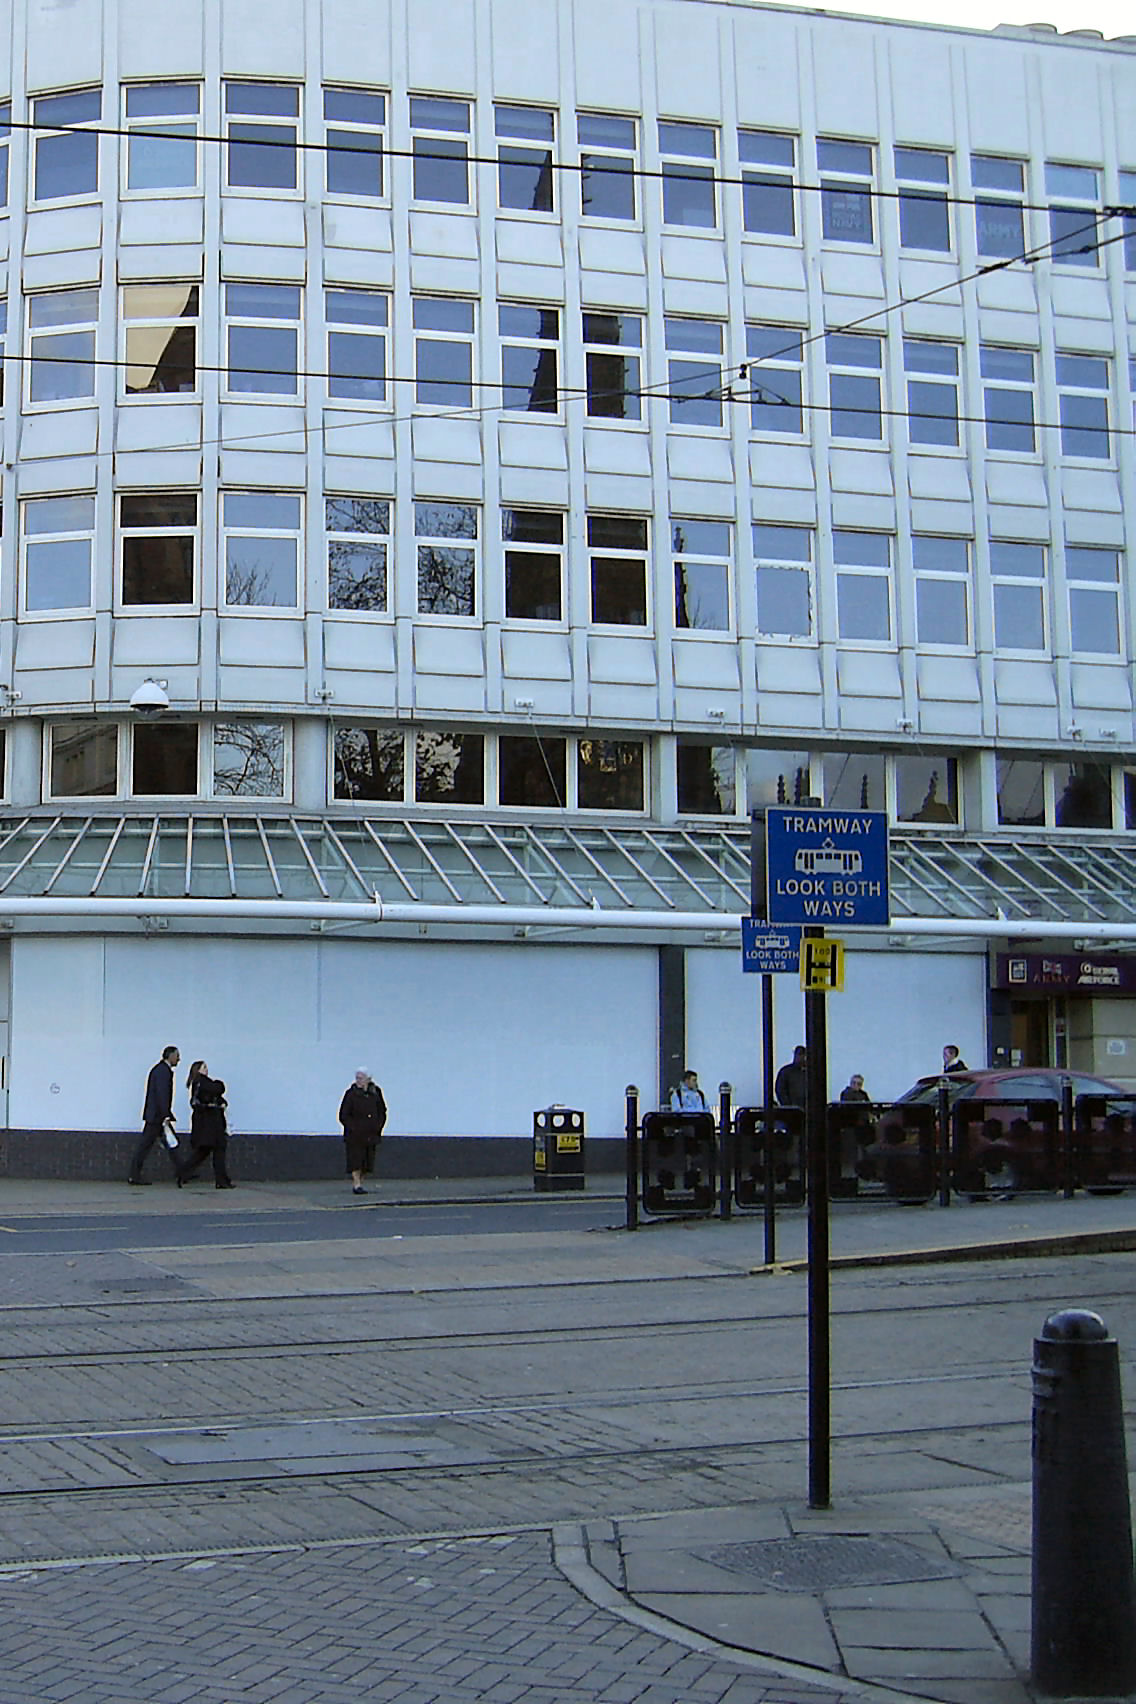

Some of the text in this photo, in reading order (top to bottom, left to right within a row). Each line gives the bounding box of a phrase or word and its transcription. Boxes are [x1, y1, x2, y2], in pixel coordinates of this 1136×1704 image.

[783, 816, 872, 834] TRAMWAY
[776, 879, 881, 897] LOOK BOTH
[804, 900, 855, 917] WAYS
[746, 950, 800, 960] LOOK BOTH
[760, 960, 786, 970] WAYS
